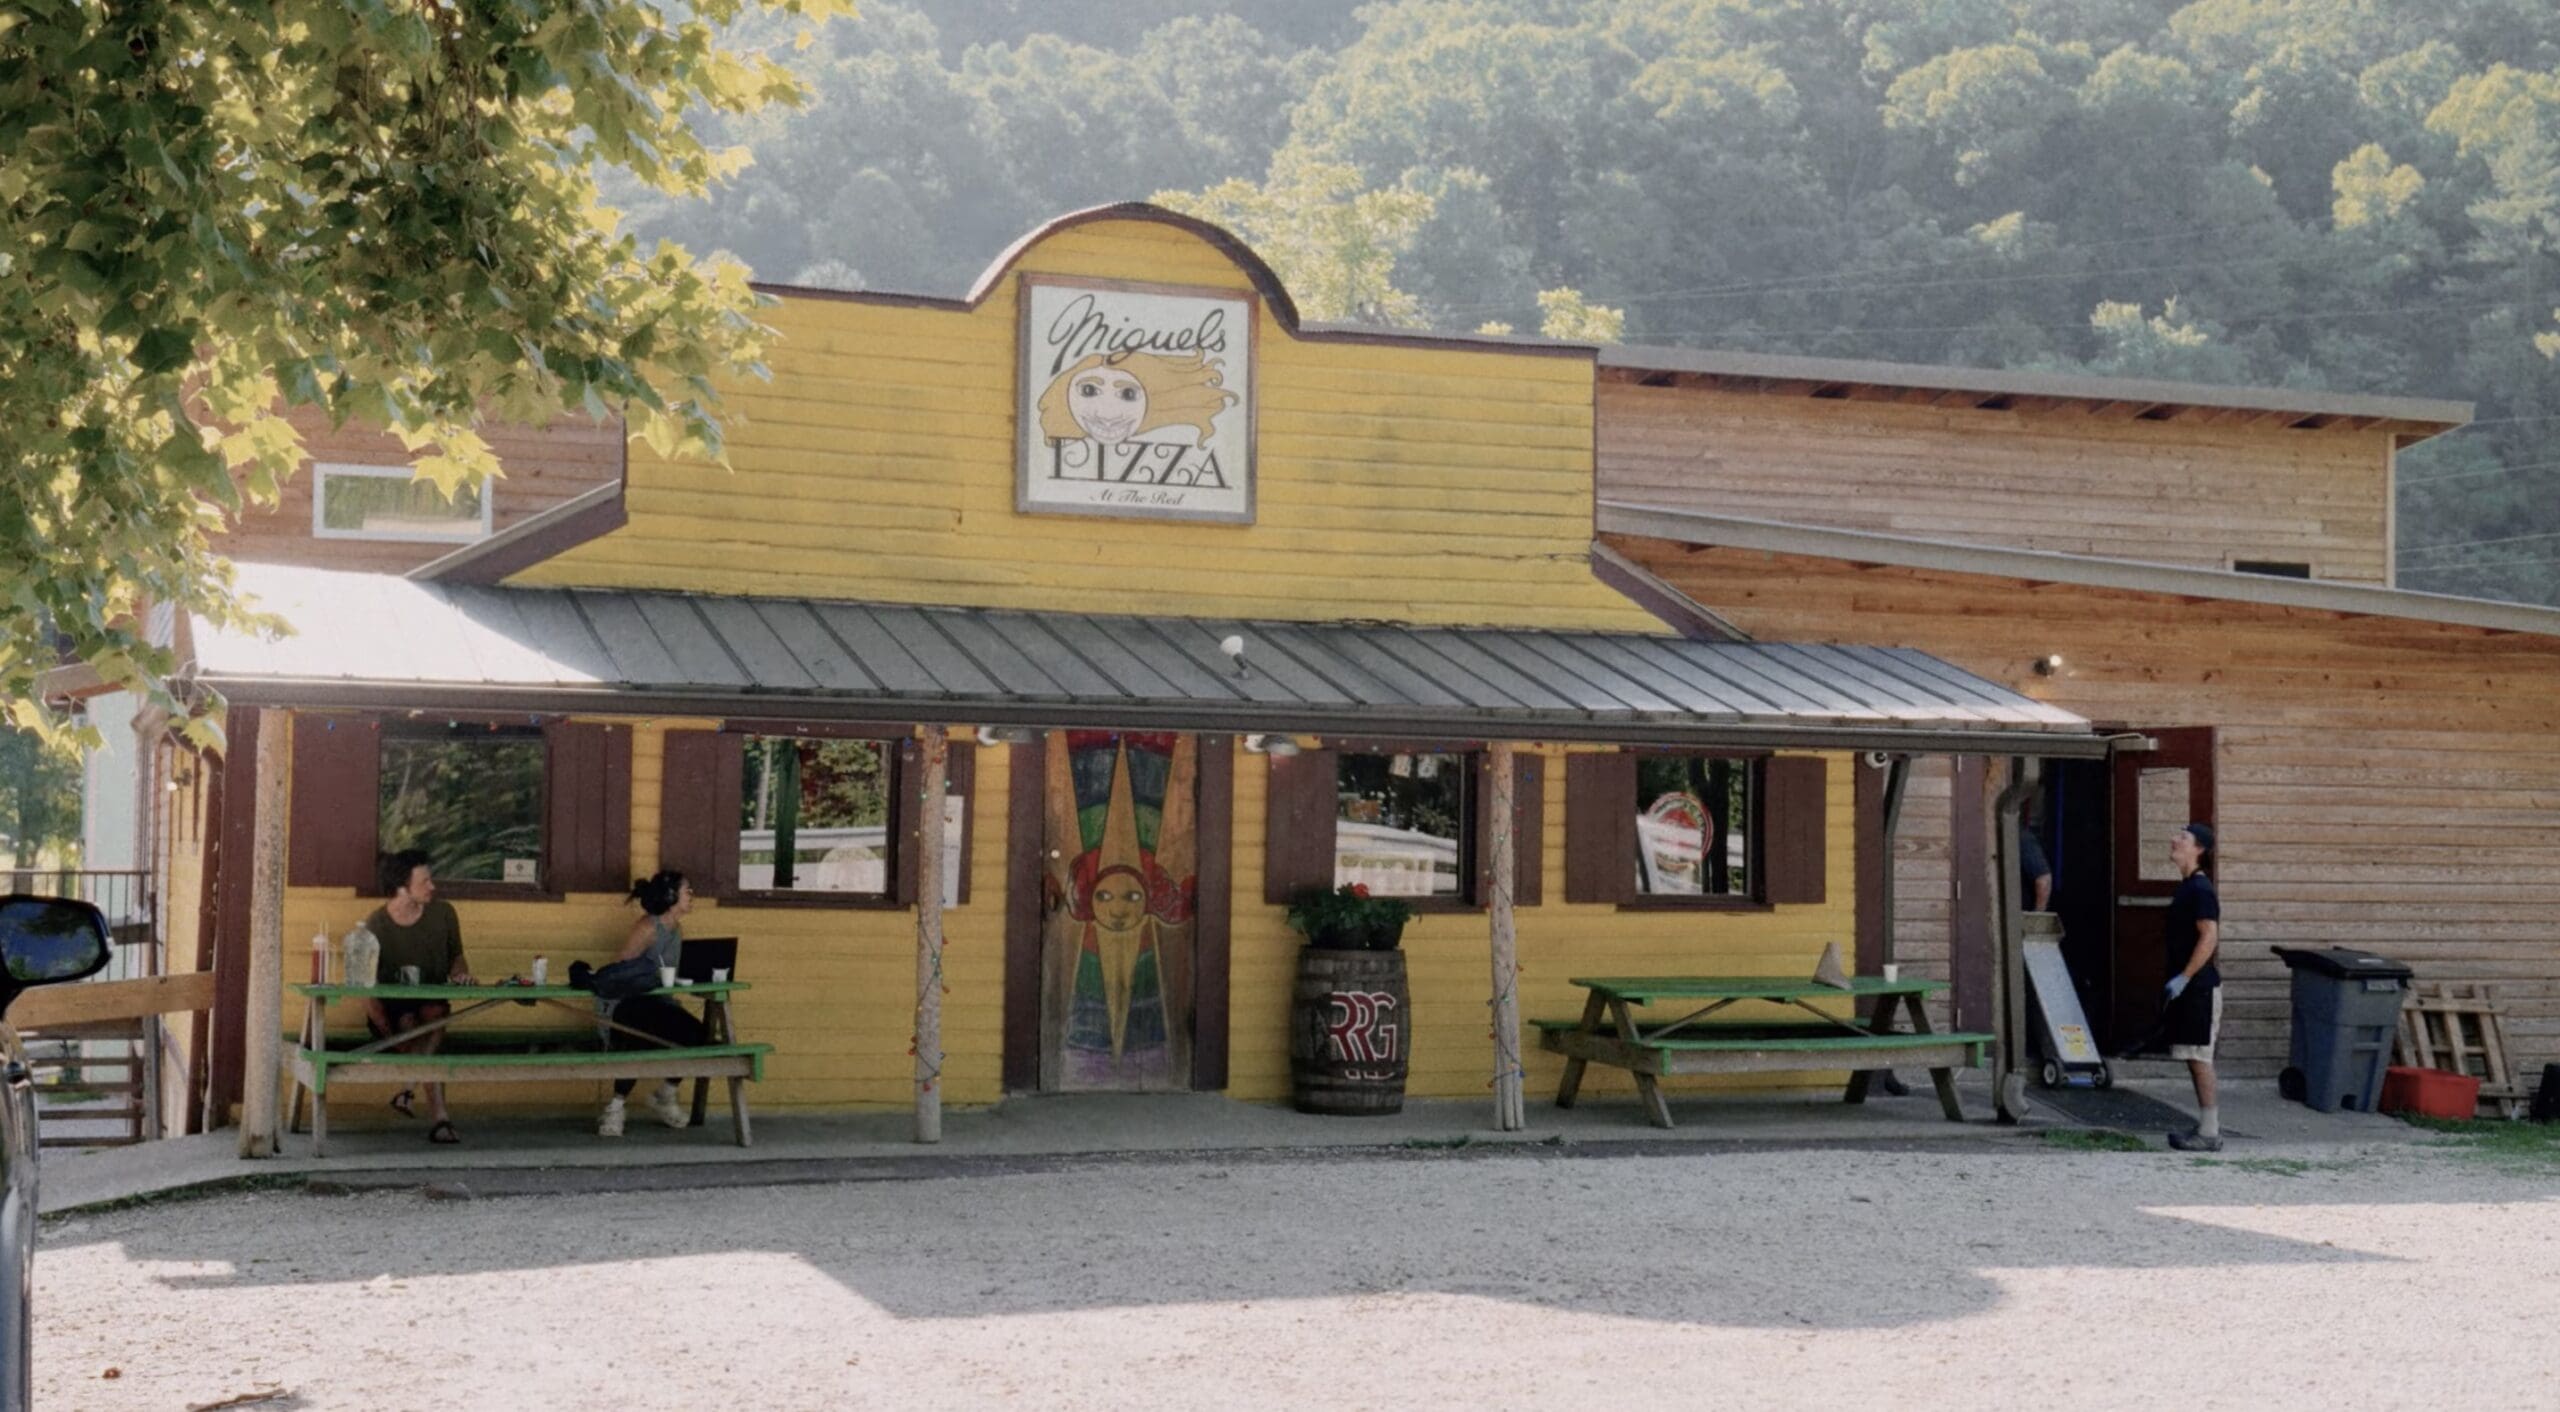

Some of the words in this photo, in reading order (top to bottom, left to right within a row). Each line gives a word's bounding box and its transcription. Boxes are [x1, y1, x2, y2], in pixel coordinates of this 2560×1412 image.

[1048, 436, 1232, 489] PIZZA
[1090, 489, 1113, 502] At
[1118, 490, 1147, 504] The
[1150, 492, 1185, 507] Red
[1328, 991, 1397, 1080] RRG
